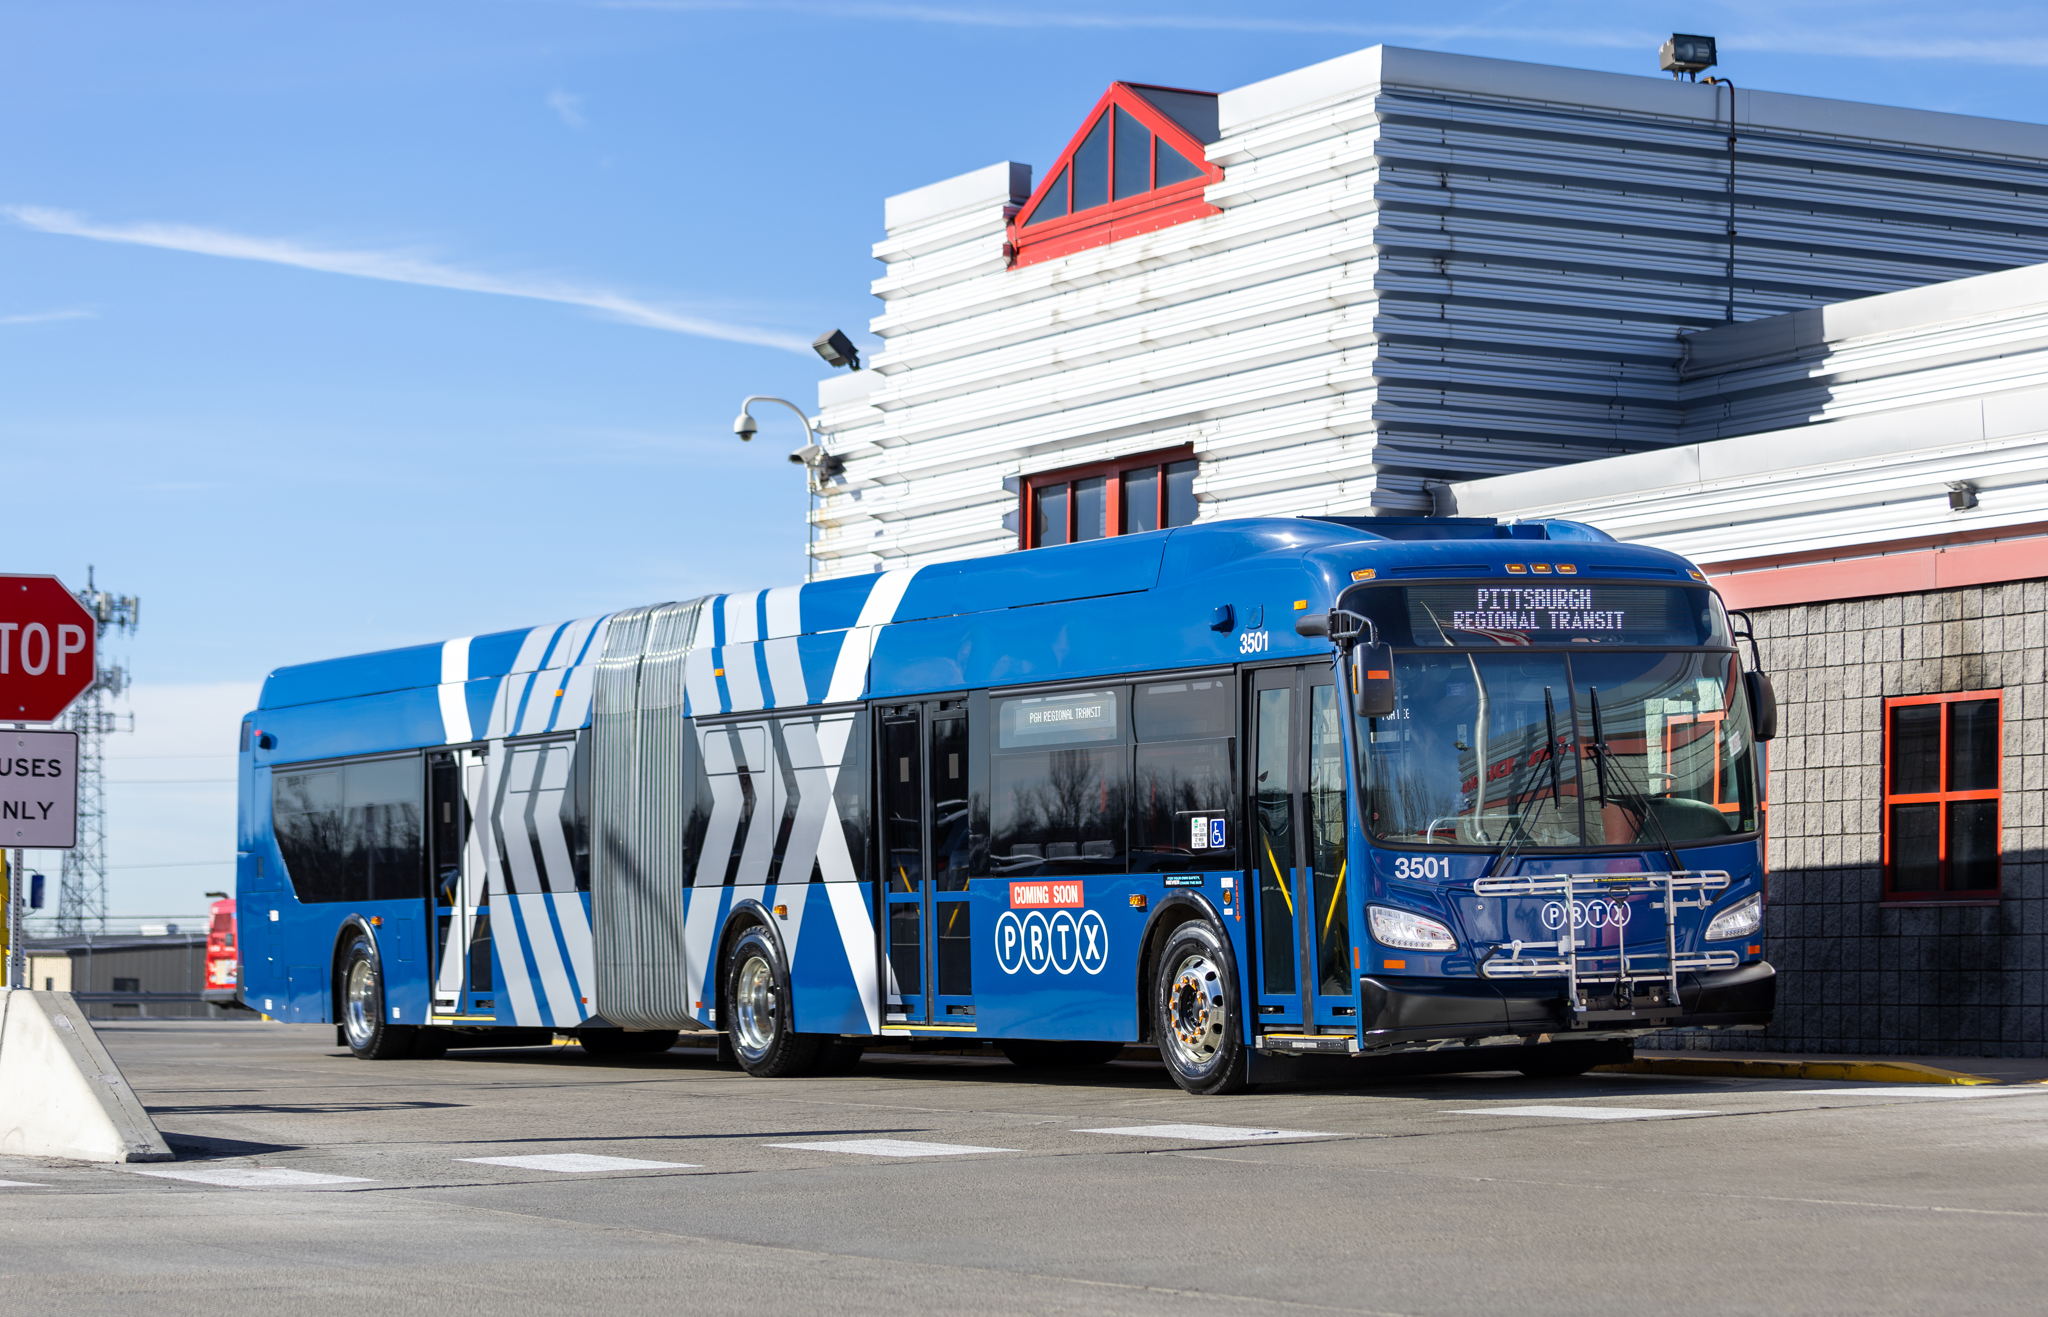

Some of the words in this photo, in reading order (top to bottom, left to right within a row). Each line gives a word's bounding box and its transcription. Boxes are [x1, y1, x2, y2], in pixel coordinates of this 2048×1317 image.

[1477, 588, 1591, 610] PITTSBURGH
[1453, 611, 1540, 629] REGIONAL
[1548, 611, 1625, 629] TRANSIT
[1240, 631, 1268, 654] 3501
[1029, 712, 1042, 723] PGH
[1043, 708, 1074, 722] REGIONAL
[1075, 706, 1101, 719] TRANSIT
[1394, 856, 1449, 879] 3501
[1014, 886, 1049, 904] COMING
[1053, 885, 1078, 903] SOON
